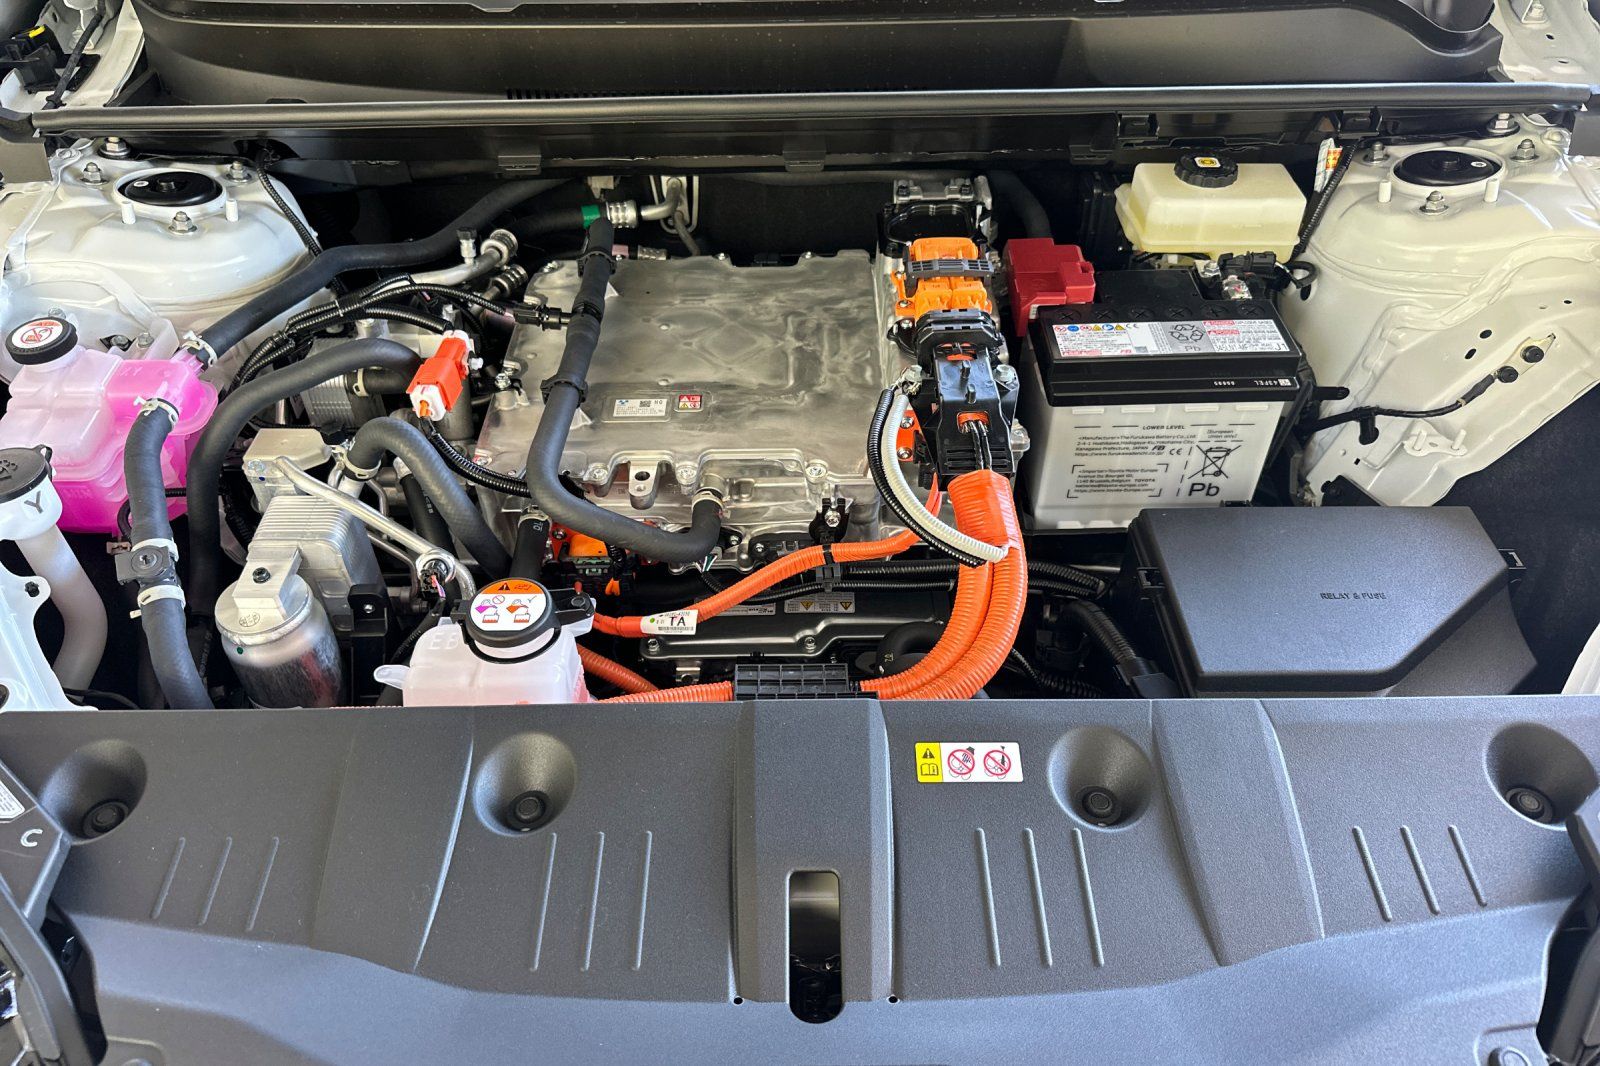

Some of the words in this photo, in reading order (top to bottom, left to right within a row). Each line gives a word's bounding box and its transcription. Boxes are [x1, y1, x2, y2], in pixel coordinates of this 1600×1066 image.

[1188, 482, 1220, 496] Pb
[24, 490, 43, 514] Y
[669, 616, 686, 626] TA
[20, 828, 43, 847] C
